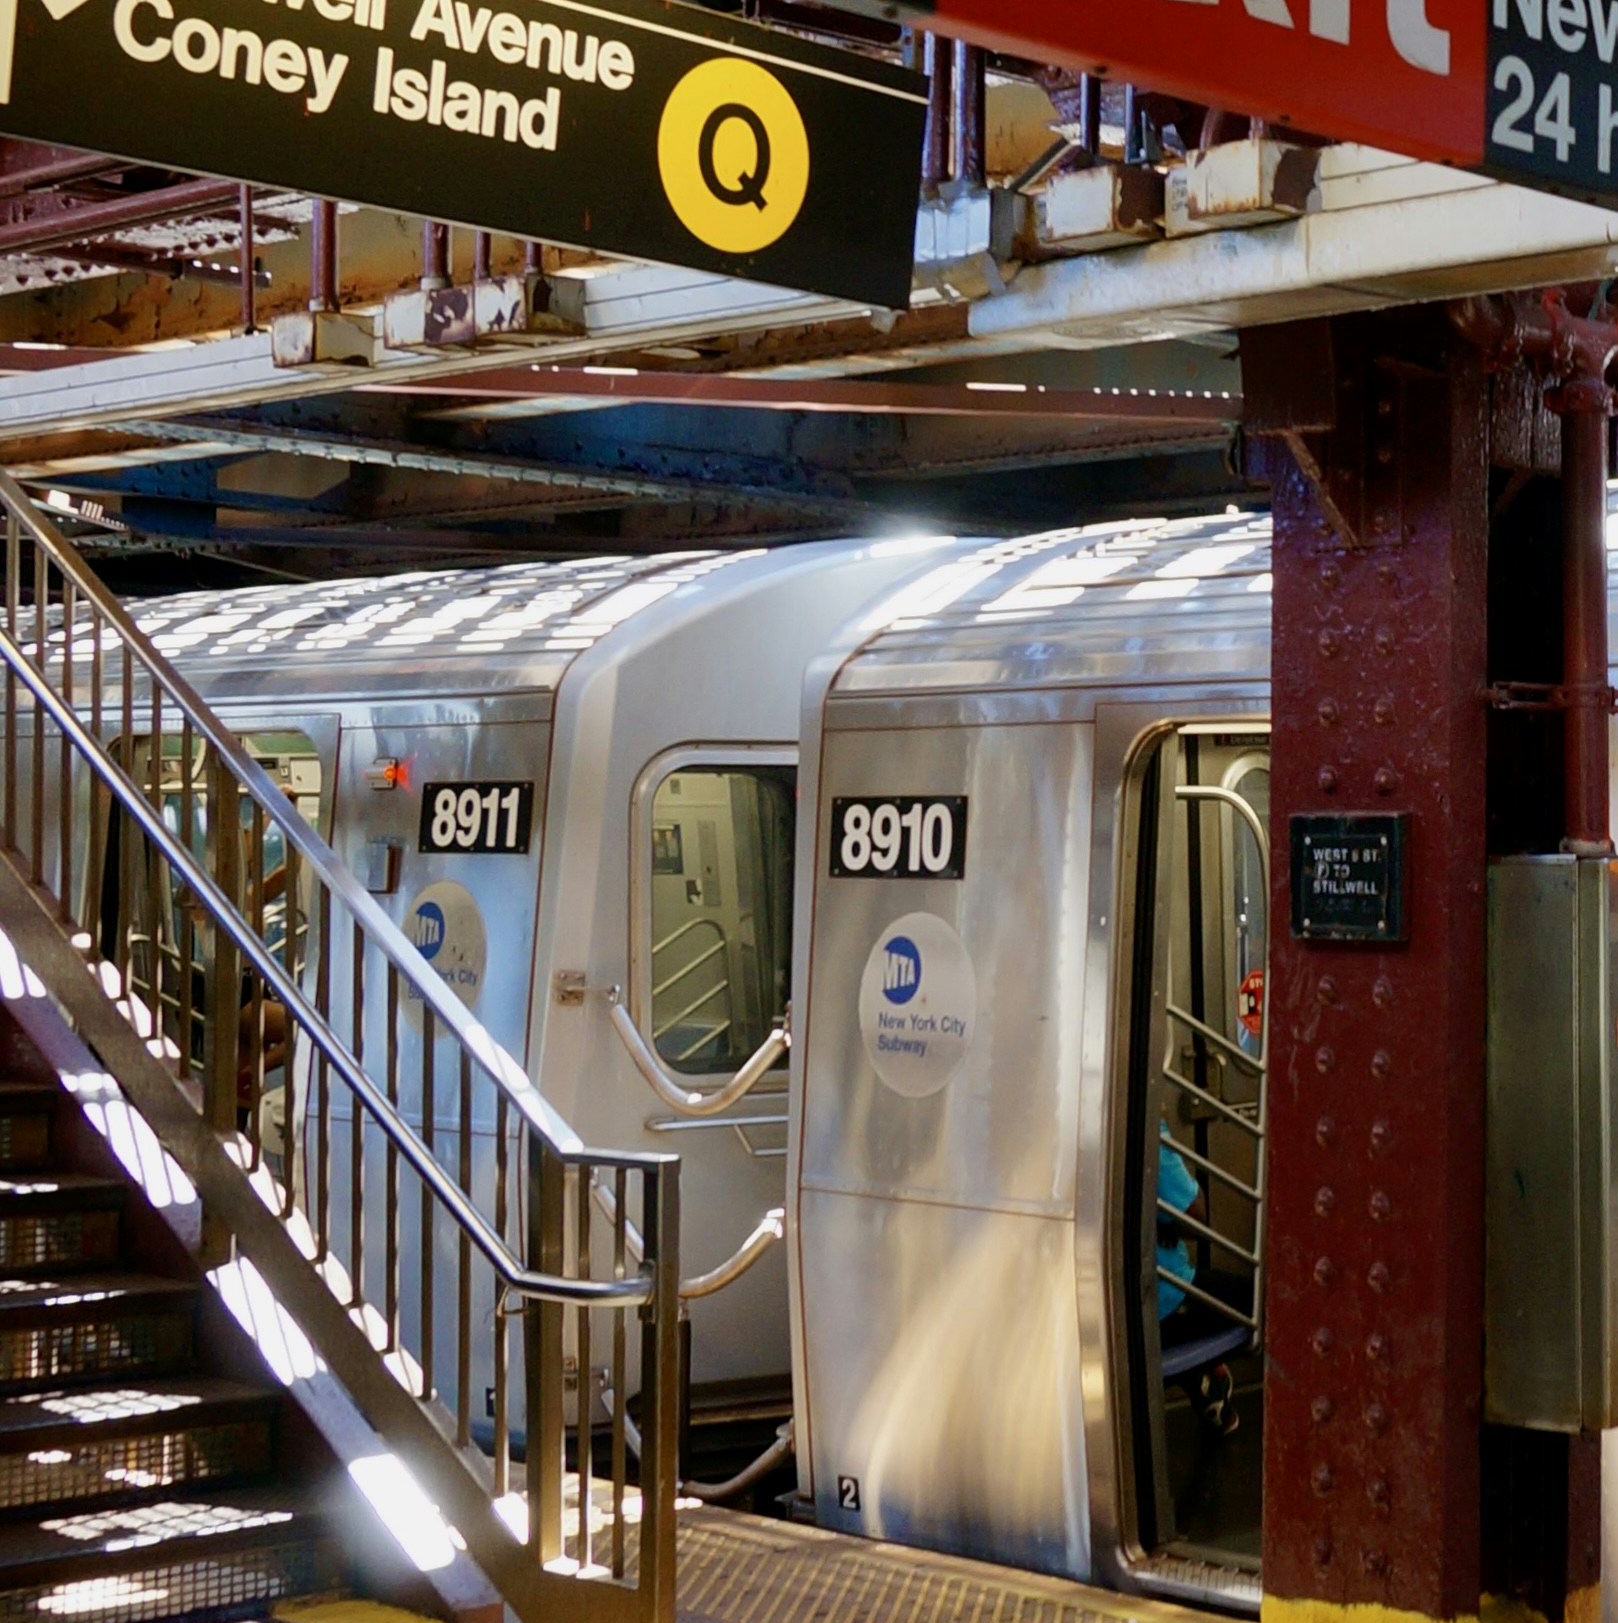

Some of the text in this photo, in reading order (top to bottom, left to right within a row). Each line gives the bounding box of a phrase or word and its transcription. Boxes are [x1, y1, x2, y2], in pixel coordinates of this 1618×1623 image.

[373, 47, 561, 152] Island
[1492, 54, 1576, 162] 24
[697, 102, 771, 212] Q
[430, 786, 521, 848] 8911
[840, 802, 954, 873] 8910
[1312, 847, 1349, 862] WEST
[1332, 864, 1351, 879] TO
[1312, 879, 1379, 895] STILLWELL
[459, 968, 478, 987] City
[878, 1012, 967, 1038] New York City
[878, 1033, 928, 1058] Subway
[841, 1478, 857, 1509] 2
